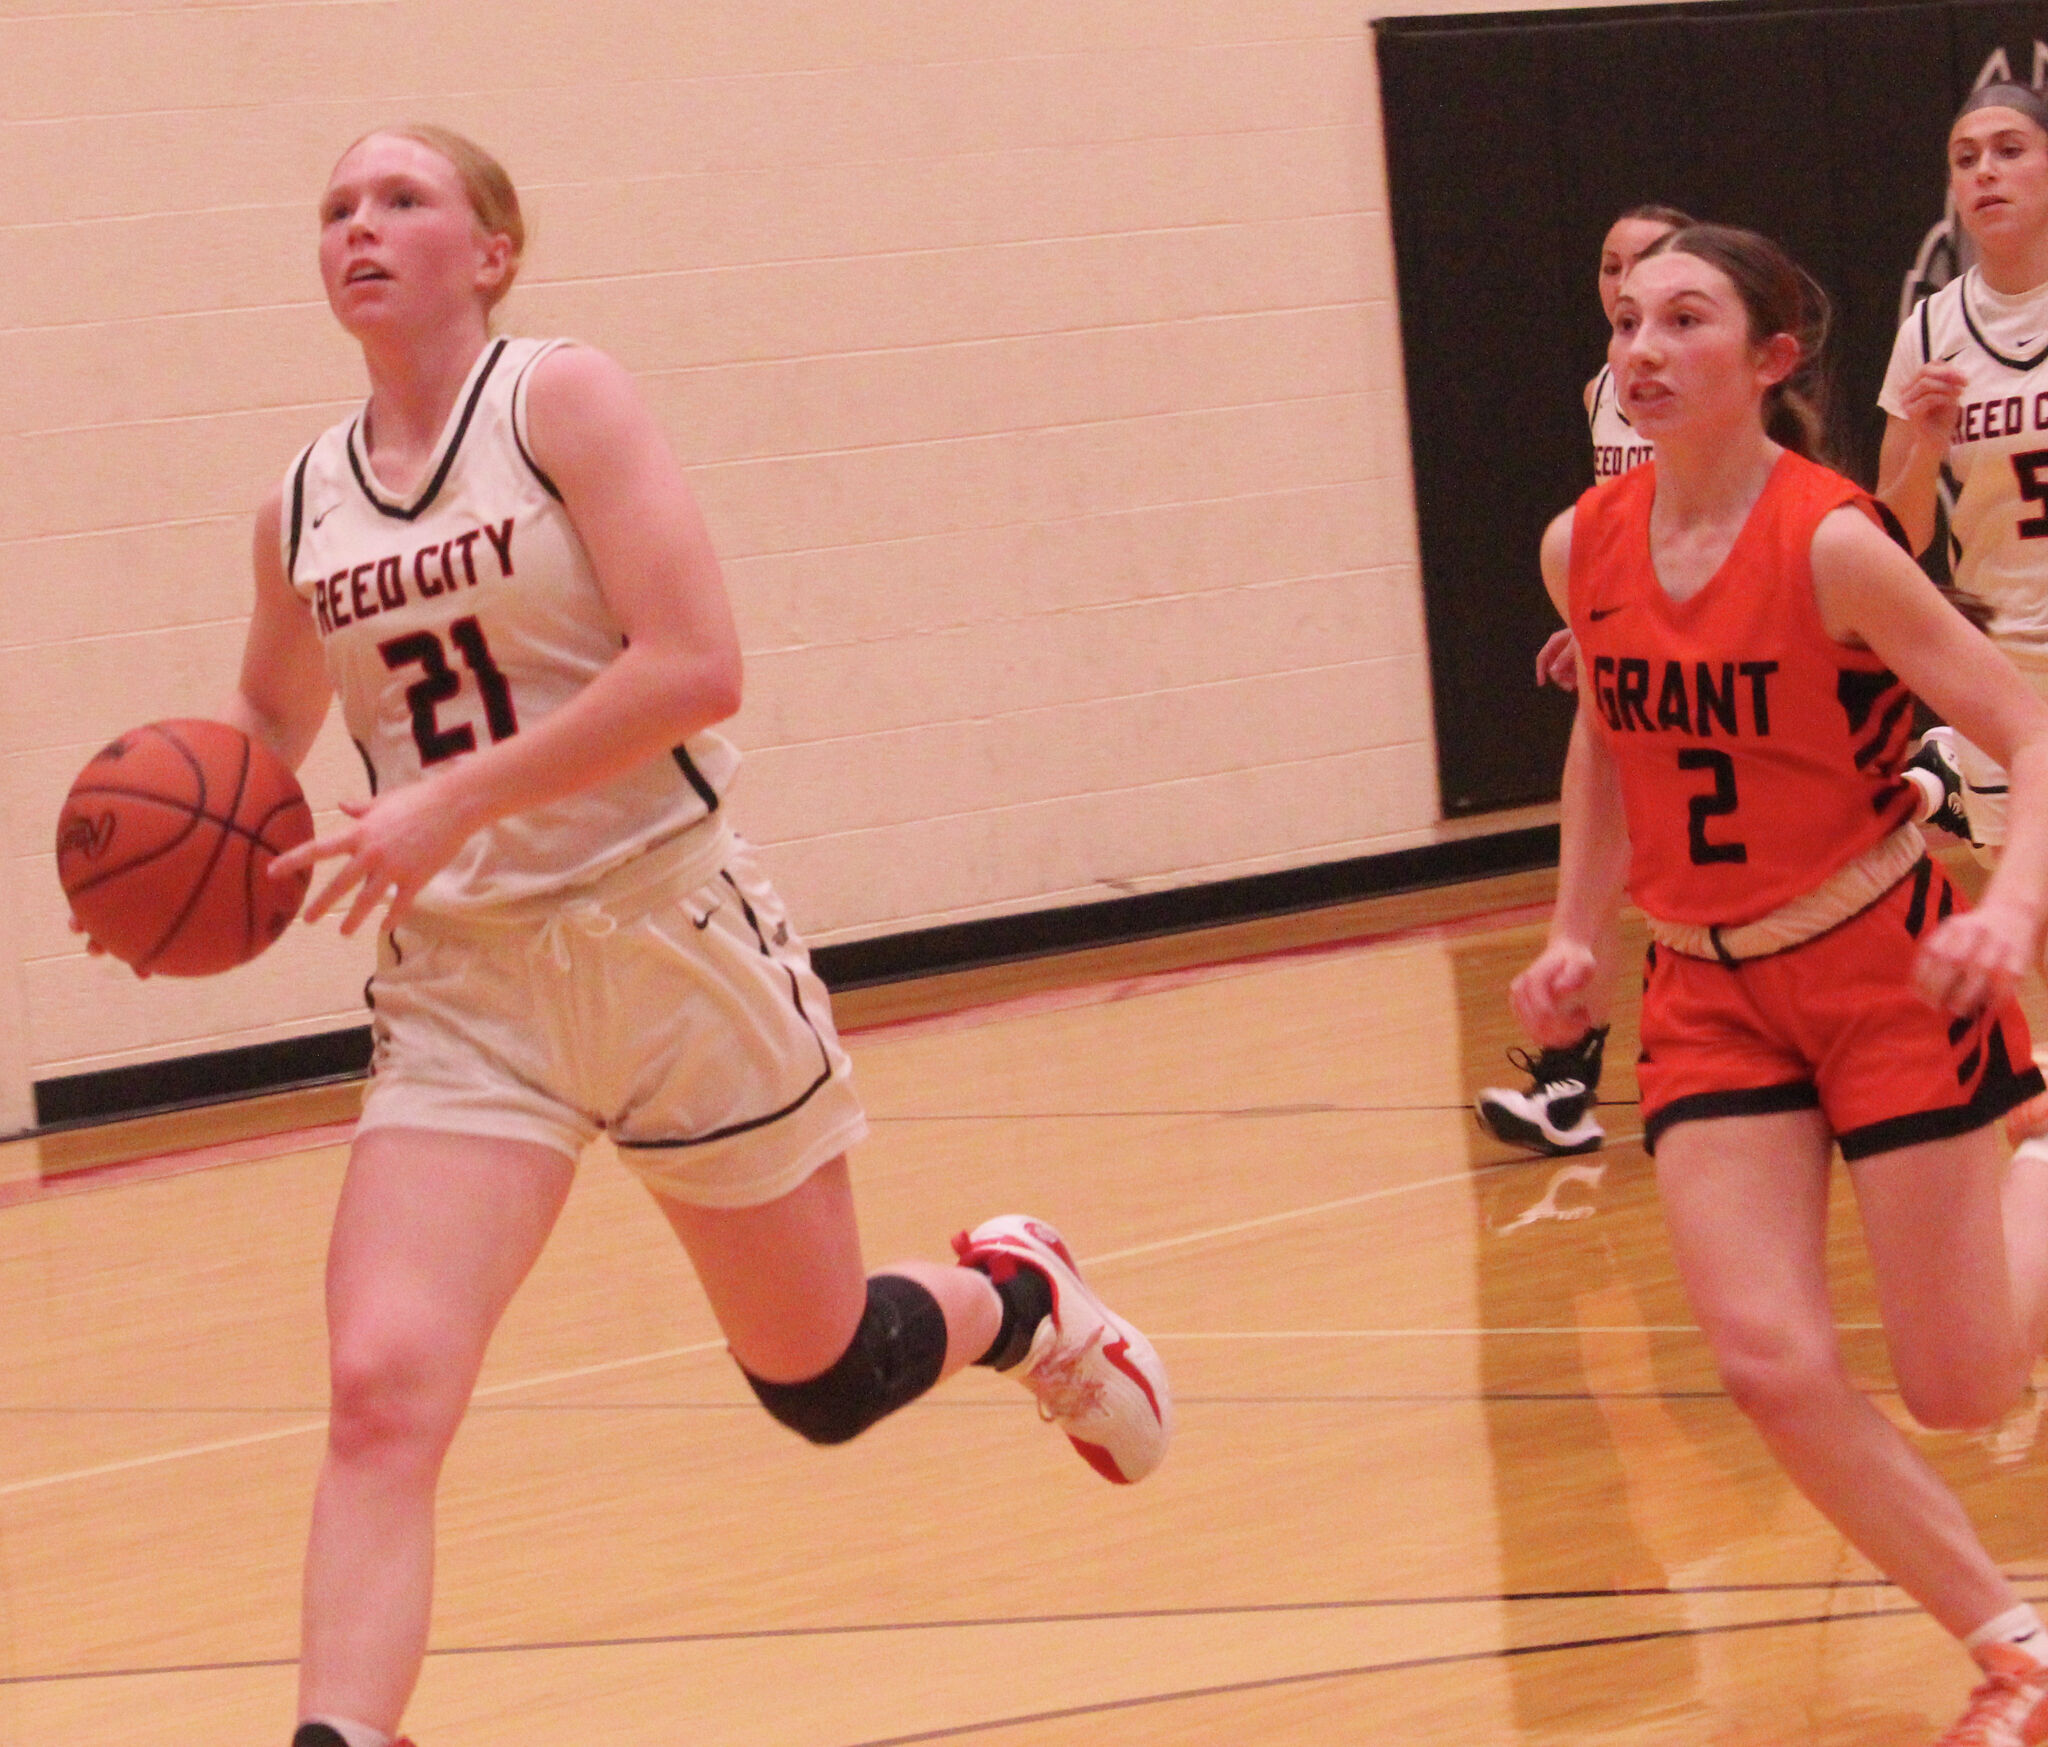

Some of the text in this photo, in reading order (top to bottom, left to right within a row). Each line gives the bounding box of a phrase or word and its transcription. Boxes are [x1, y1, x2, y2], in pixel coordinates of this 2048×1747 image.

[1594, 446, 1653, 476] EED CIT
[1951, 396, 2022, 444] EED
[314, 517, 515, 636] REED CITY
[377, 614, 519, 768] 21
[1594, 656, 1779, 737] GRANT
[1678, 748, 1747, 866] 2
